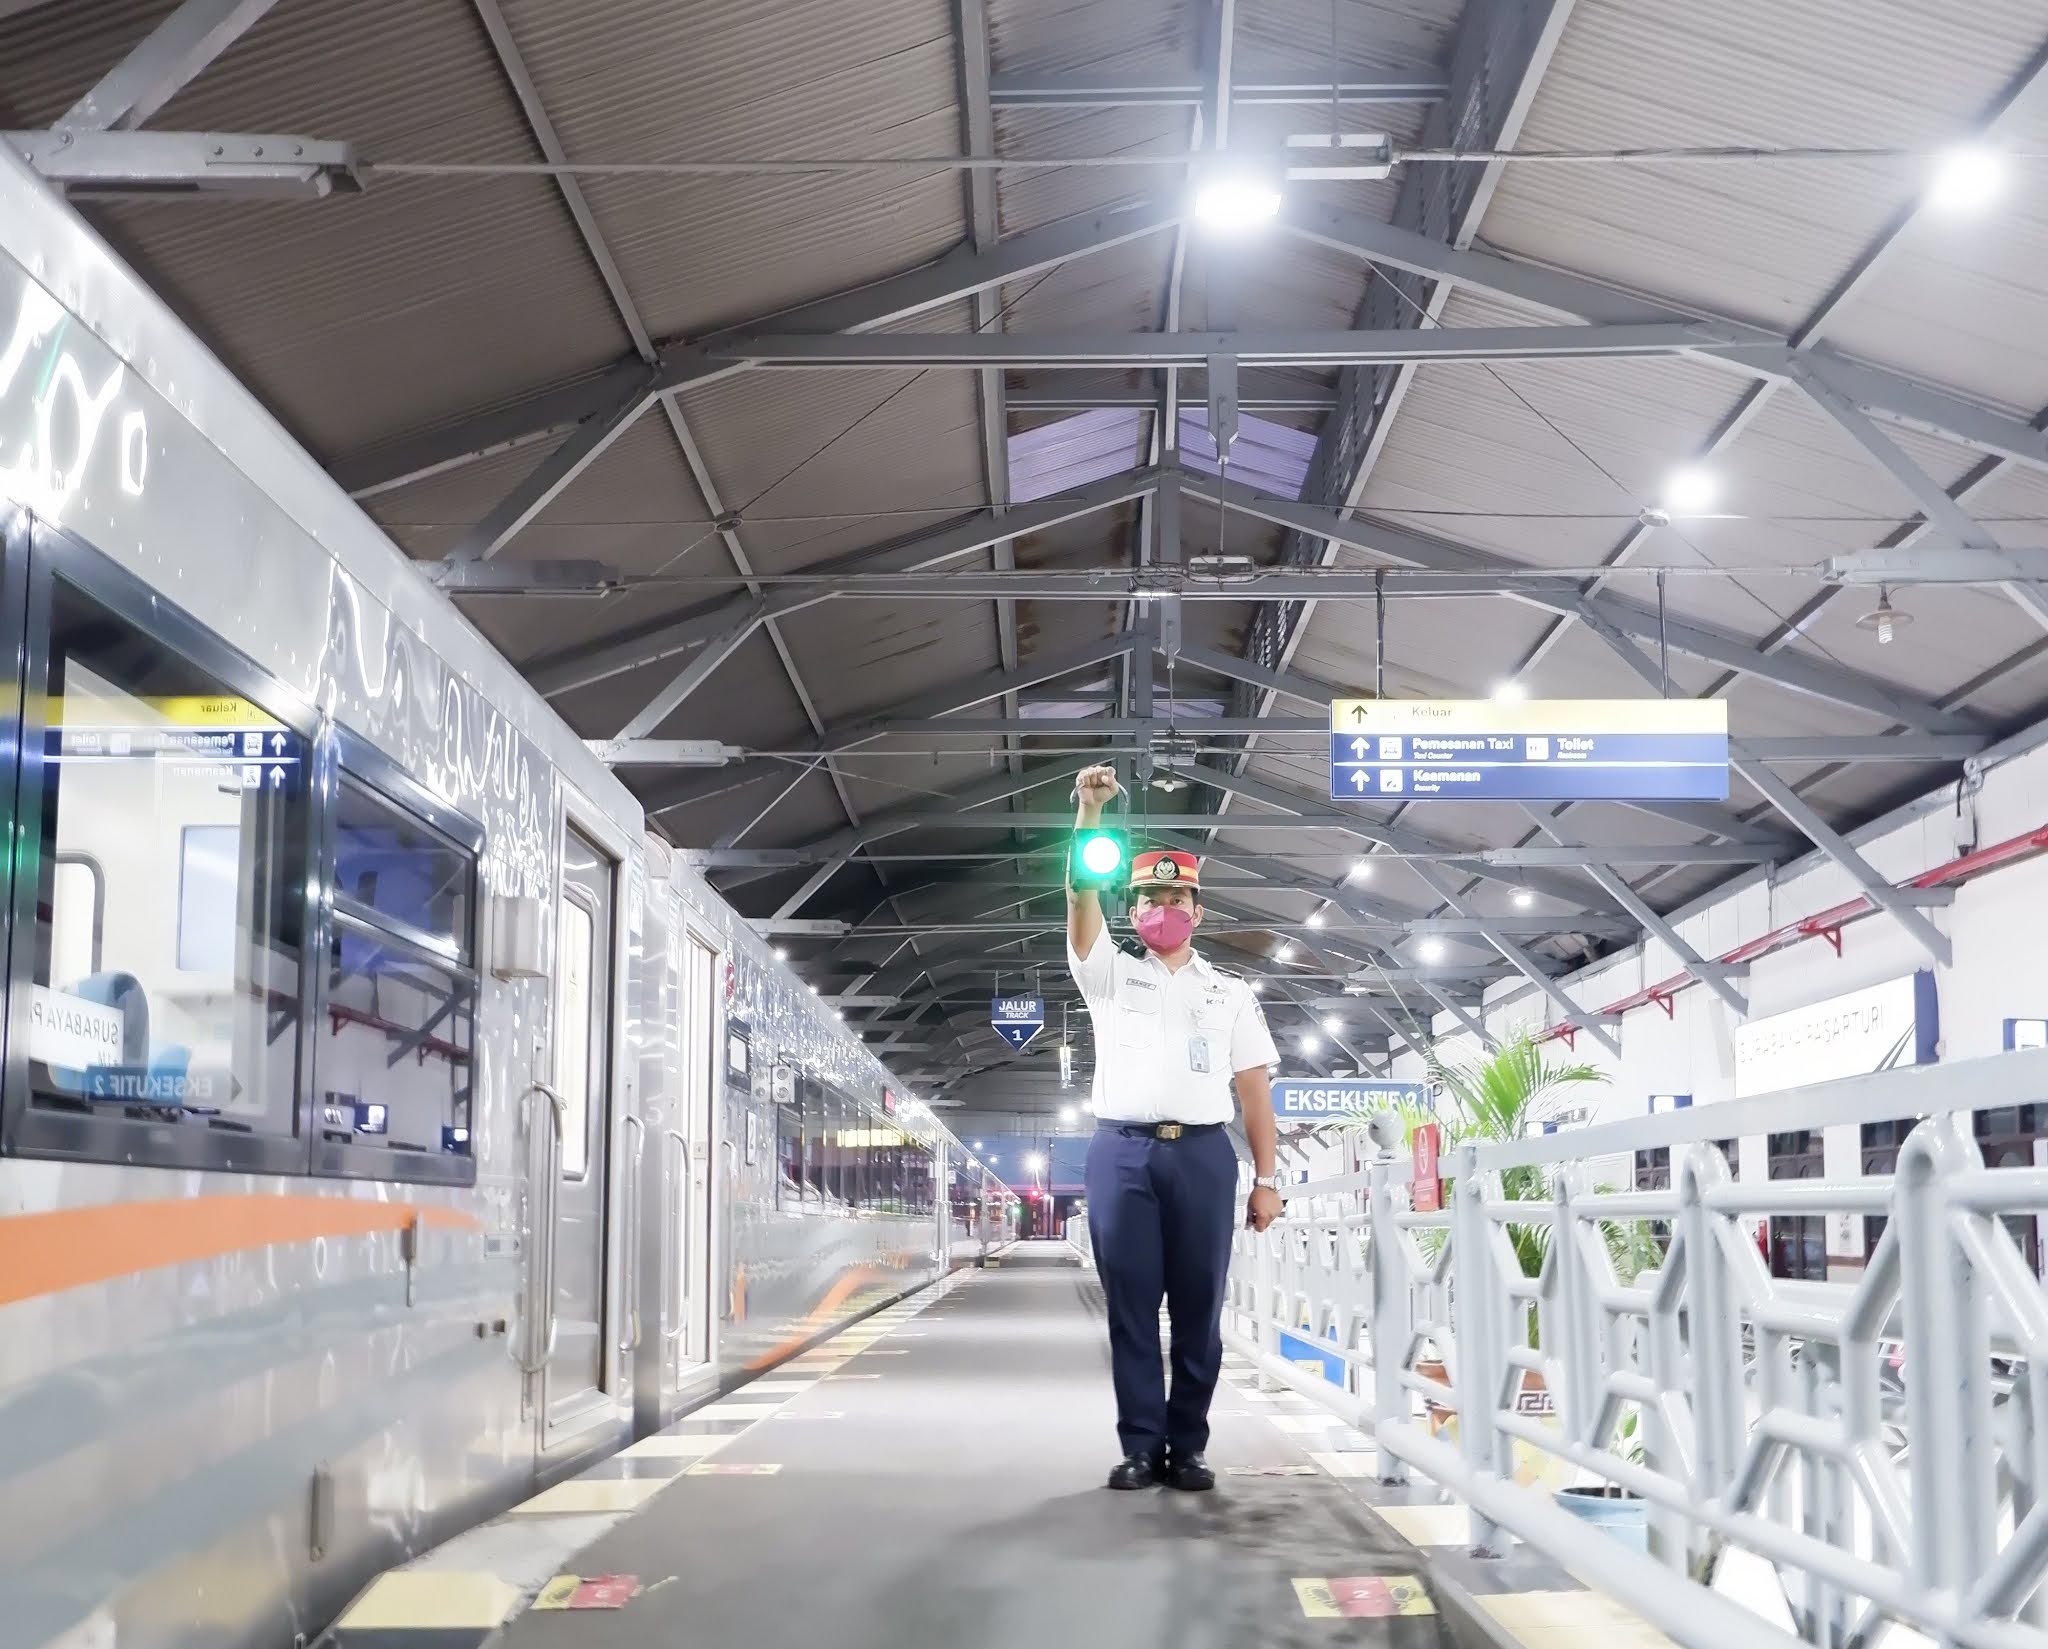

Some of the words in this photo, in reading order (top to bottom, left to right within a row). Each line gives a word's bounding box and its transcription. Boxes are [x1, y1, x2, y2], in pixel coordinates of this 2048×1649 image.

[1412, 706, 1453, 717] Keluar
[1412, 737, 1486, 750] Pemesanan
[1487, 737, 1514, 750] Taxi
[1557, 737, 1594, 751] Toilet
[1413, 769, 1481, 782] Keamanan
[998, 1000, 1037, 1011] JALUR
[1012, 1029, 1024, 1041] 1
[1284, 1089, 1401, 1111] EKSEKUTIF
[1404, 1091, 1418, 1112] 2
[1352, 1589, 1372, 1599] 2
